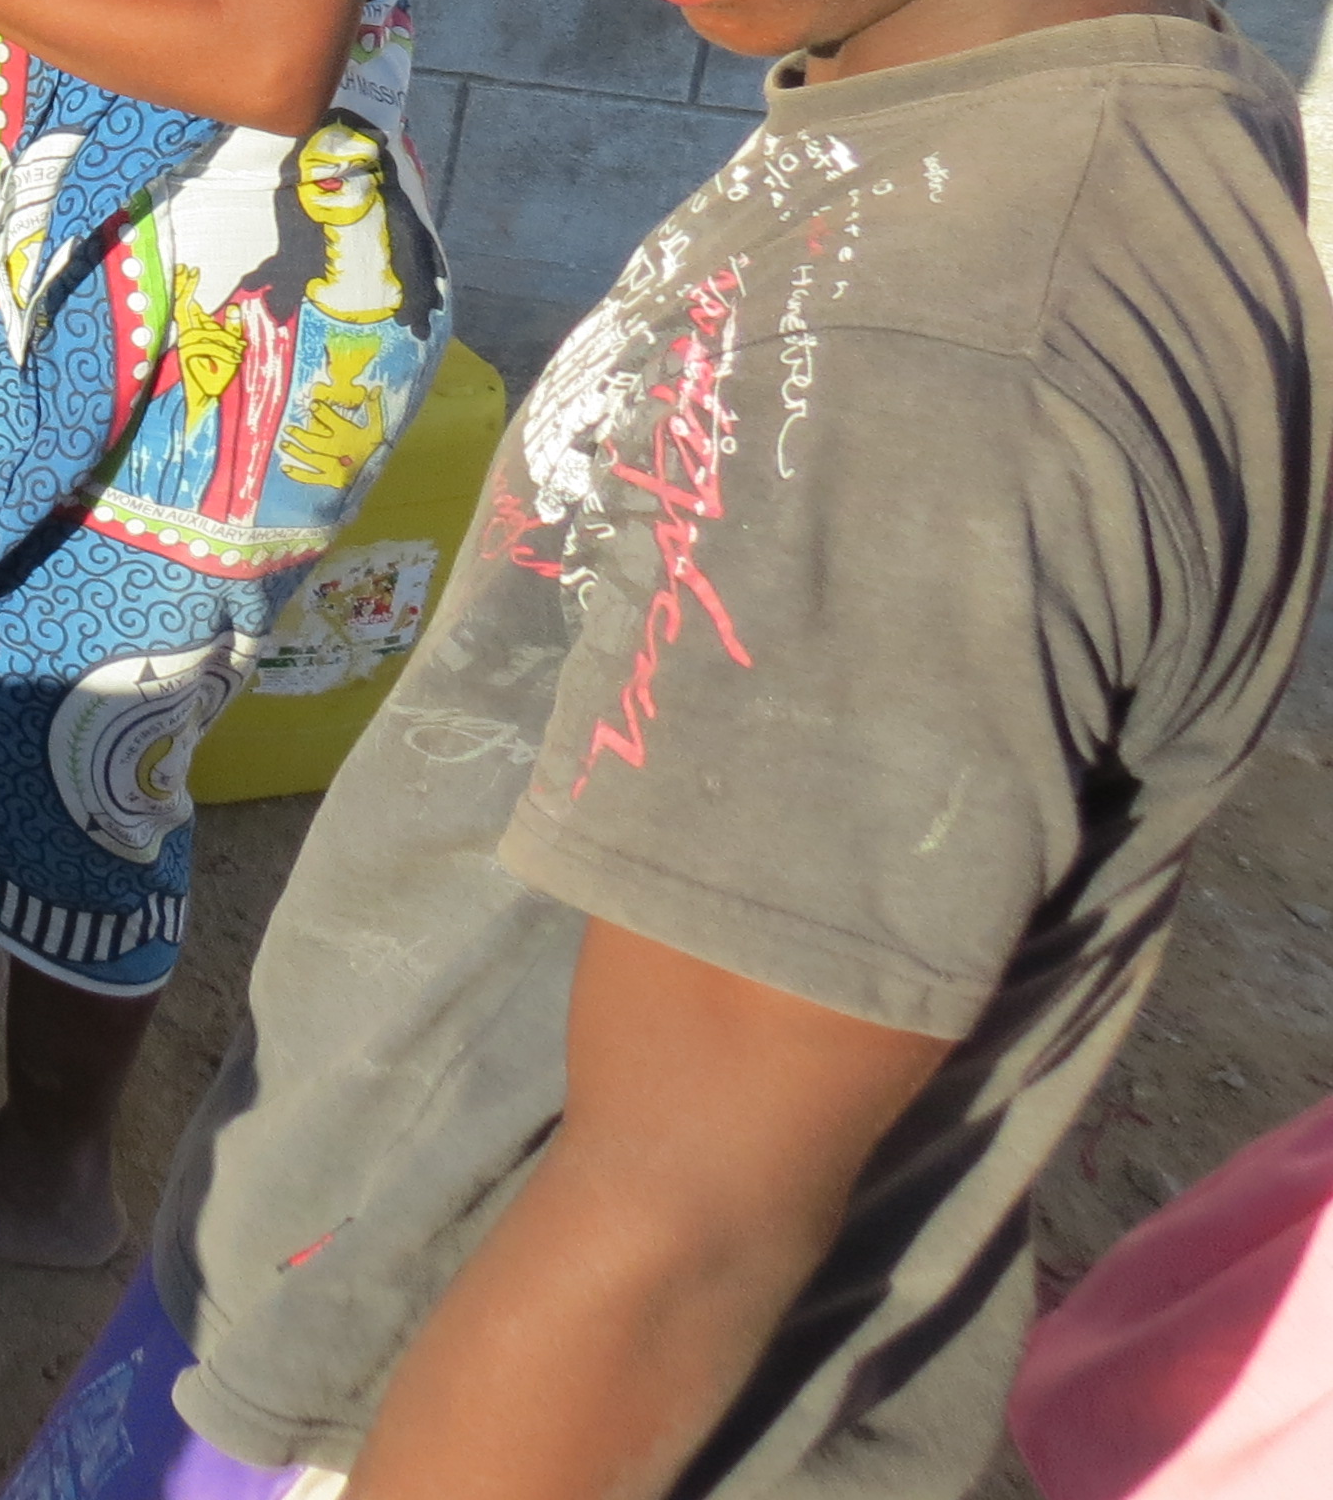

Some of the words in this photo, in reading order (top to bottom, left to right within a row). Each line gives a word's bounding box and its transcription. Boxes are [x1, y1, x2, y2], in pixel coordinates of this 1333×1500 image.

[104, 488, 170, 521] WOMEN
[164, 509, 247, 543] AUXILIARY
[158, 677, 189, 696] MY
